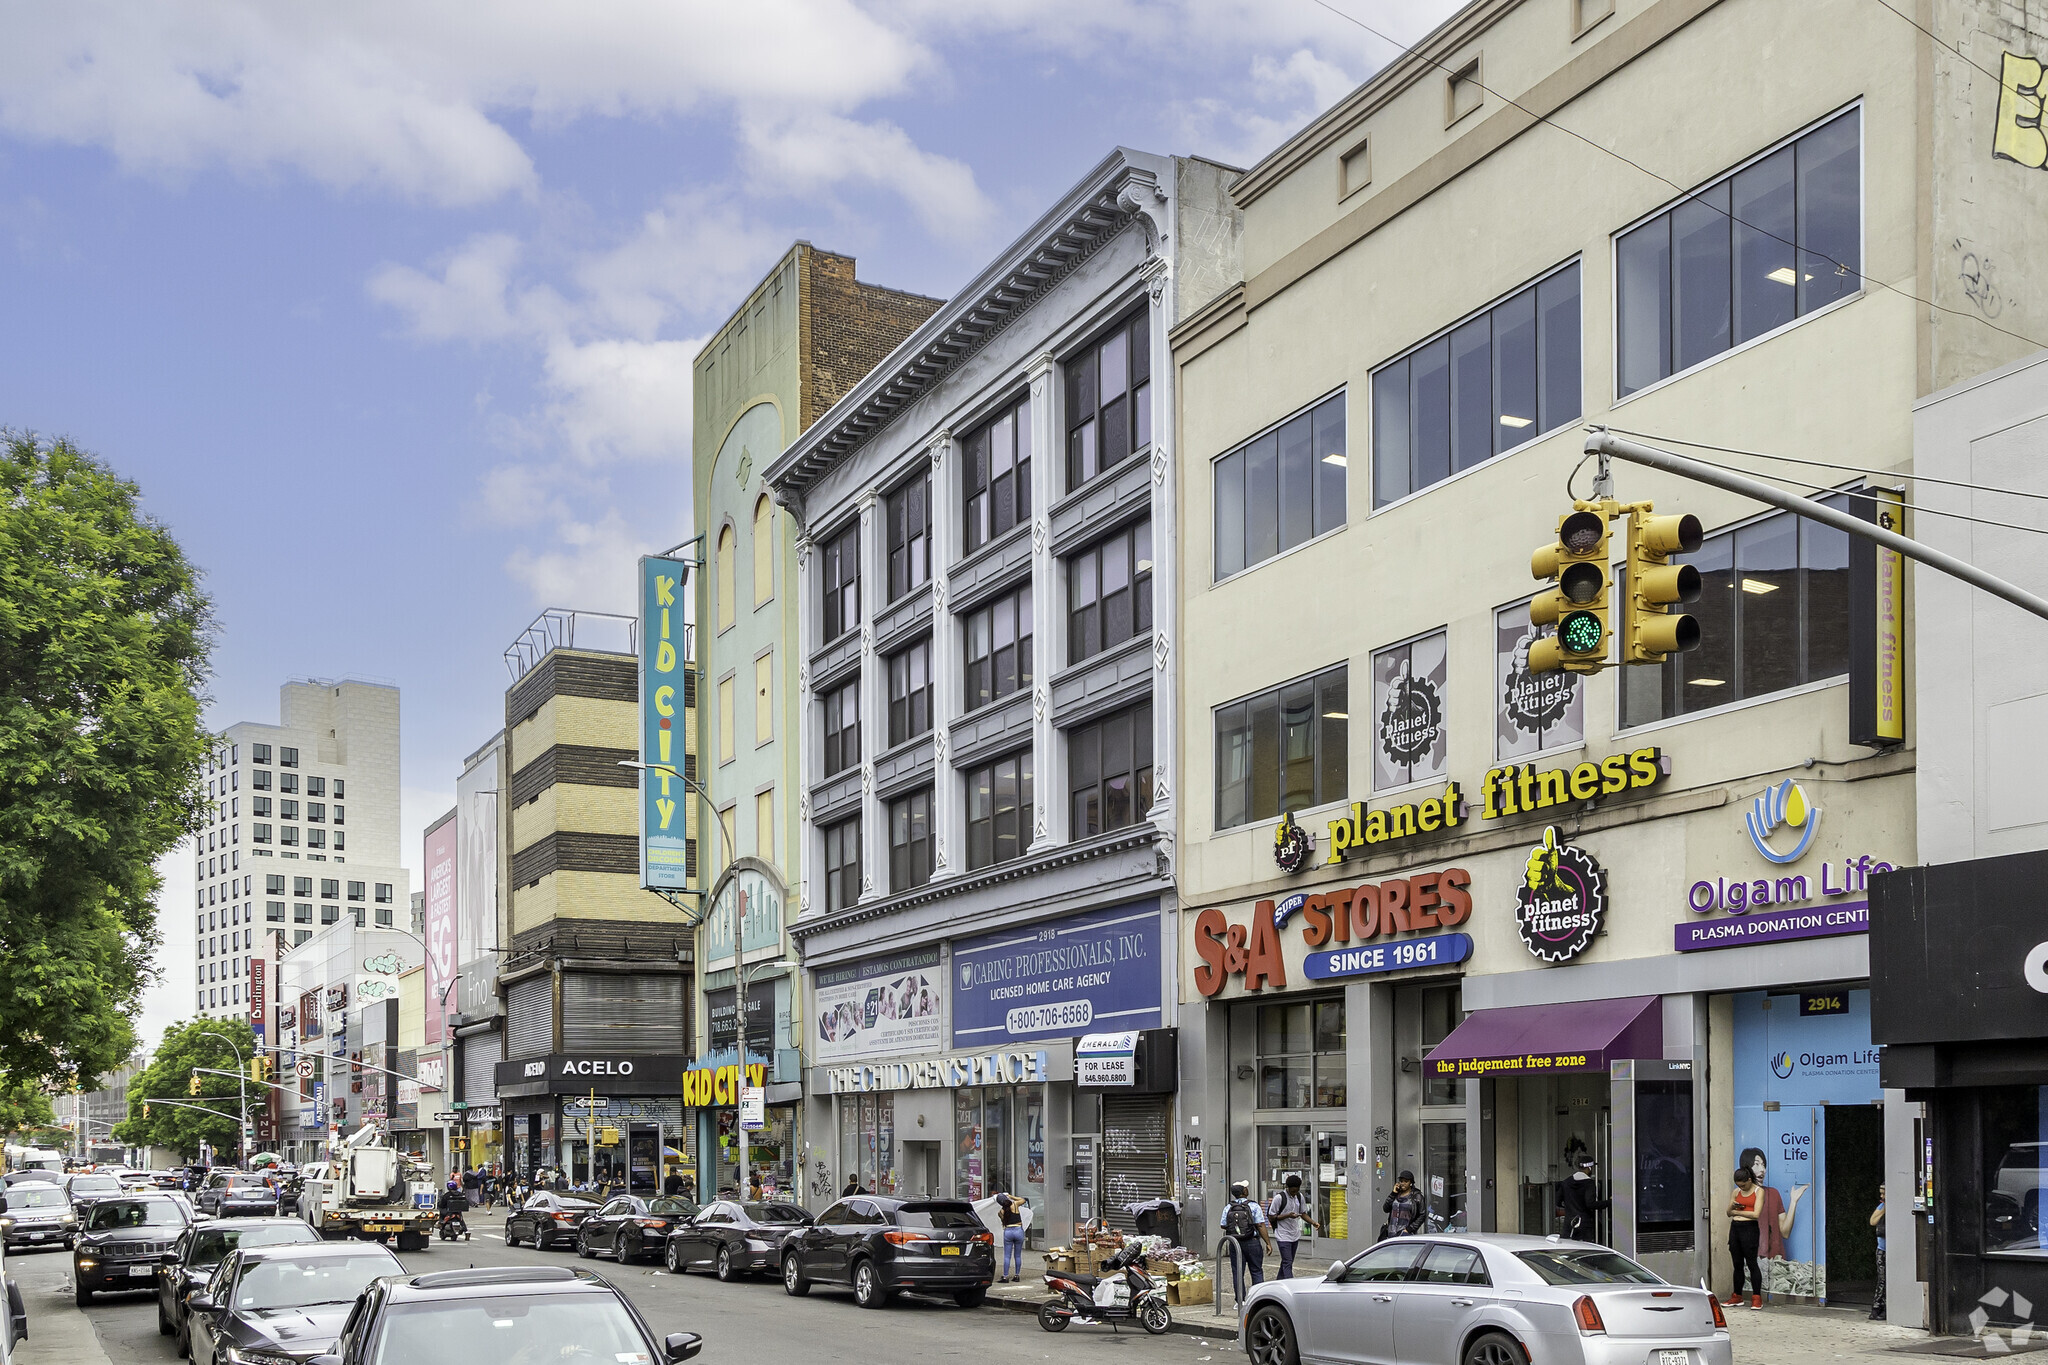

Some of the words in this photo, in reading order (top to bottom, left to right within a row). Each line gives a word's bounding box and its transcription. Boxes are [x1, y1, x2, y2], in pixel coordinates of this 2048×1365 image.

[653, 574, 676, 673] KID
[1510, 674, 1560, 704] planet
[1882, 632, 1897, 722] fitness
[1517, 687, 1570, 714] fitness
[1386, 712, 1427, 740] planet
[1390, 725, 1436, 748] fitness
[1327, 780, 1461, 865] planet
[1480, 746, 1662, 820] fitness
[1280, 840, 1296, 858] pf
[1524, 893, 1579, 922] planet
[1689, 875, 1808, 914] Olgam
[1038, 930, 1056, 942] 2918
[1194, 900, 1287, 997] S&A
[1275, 895, 1303, 923] SUPER
[1303, 868, 1472, 947] STORES
[1531, 913, 1590, 933] fitness
[1692, 924, 1744, 941] PLASMA
[1748, 914, 1822, 935] DONATION
[431, 914, 452, 982] 5G
[974, 958, 1012, 985] CARING
[1016, 939, 1116, 979] PROFESSIONALS,
[1119, 933, 1147, 961] INC.
[1329, 948, 1384, 973] SINCE
[1392, 941, 1437, 964] 1961
[468, 970, 489, 1008] Fino
[990, 984, 1024, 1000] LICENSED
[1026, 979, 1050, 995] HOME
[1052, 976, 1074, 992] CARE
[1077, 971, 1111, 988] AGENCY
[712, 1004, 736, 1018] BUILDING
[748, 1000, 761, 1012] SALE
[1808, 996, 1840, 1011] 2914
[712, 1016, 748, 1034] 718.663.23
[1010, 1004, 1089, 1030] 1-800-706-6568
[1082, 1040, 1118, 1049] EMERALD
[524, 1061, 546, 1078] ACELO
[562, 1060, 634, 1076] ACELO
[1085, 1062, 1098, 1071] FOR
[1102, 1060, 1125, 1070] LEASE
[1436, 1060, 1455, 1074] the
[1457, 1056, 1523, 1074] judgement
[1526, 1054, 1552, 1069] free
[1555, 1054, 1586, 1067] zone
[1800, 1052, 1848, 1068] Olgam
[1853, 1050, 1880, 1064] Life
[682, 1066, 714, 1107] KID
[714, 1063, 766, 1106] CIY
[827, 1066, 861, 1094] THE
[861, 1056, 968, 1092] CHILDREN'S
[970, 1052, 1038, 1086] PLACE
[1085, 1073, 1127, 1082] 646.960.6800
[1781, 1133, 1810, 1145] Give
[1784, 1149, 1808, 1160] Life
